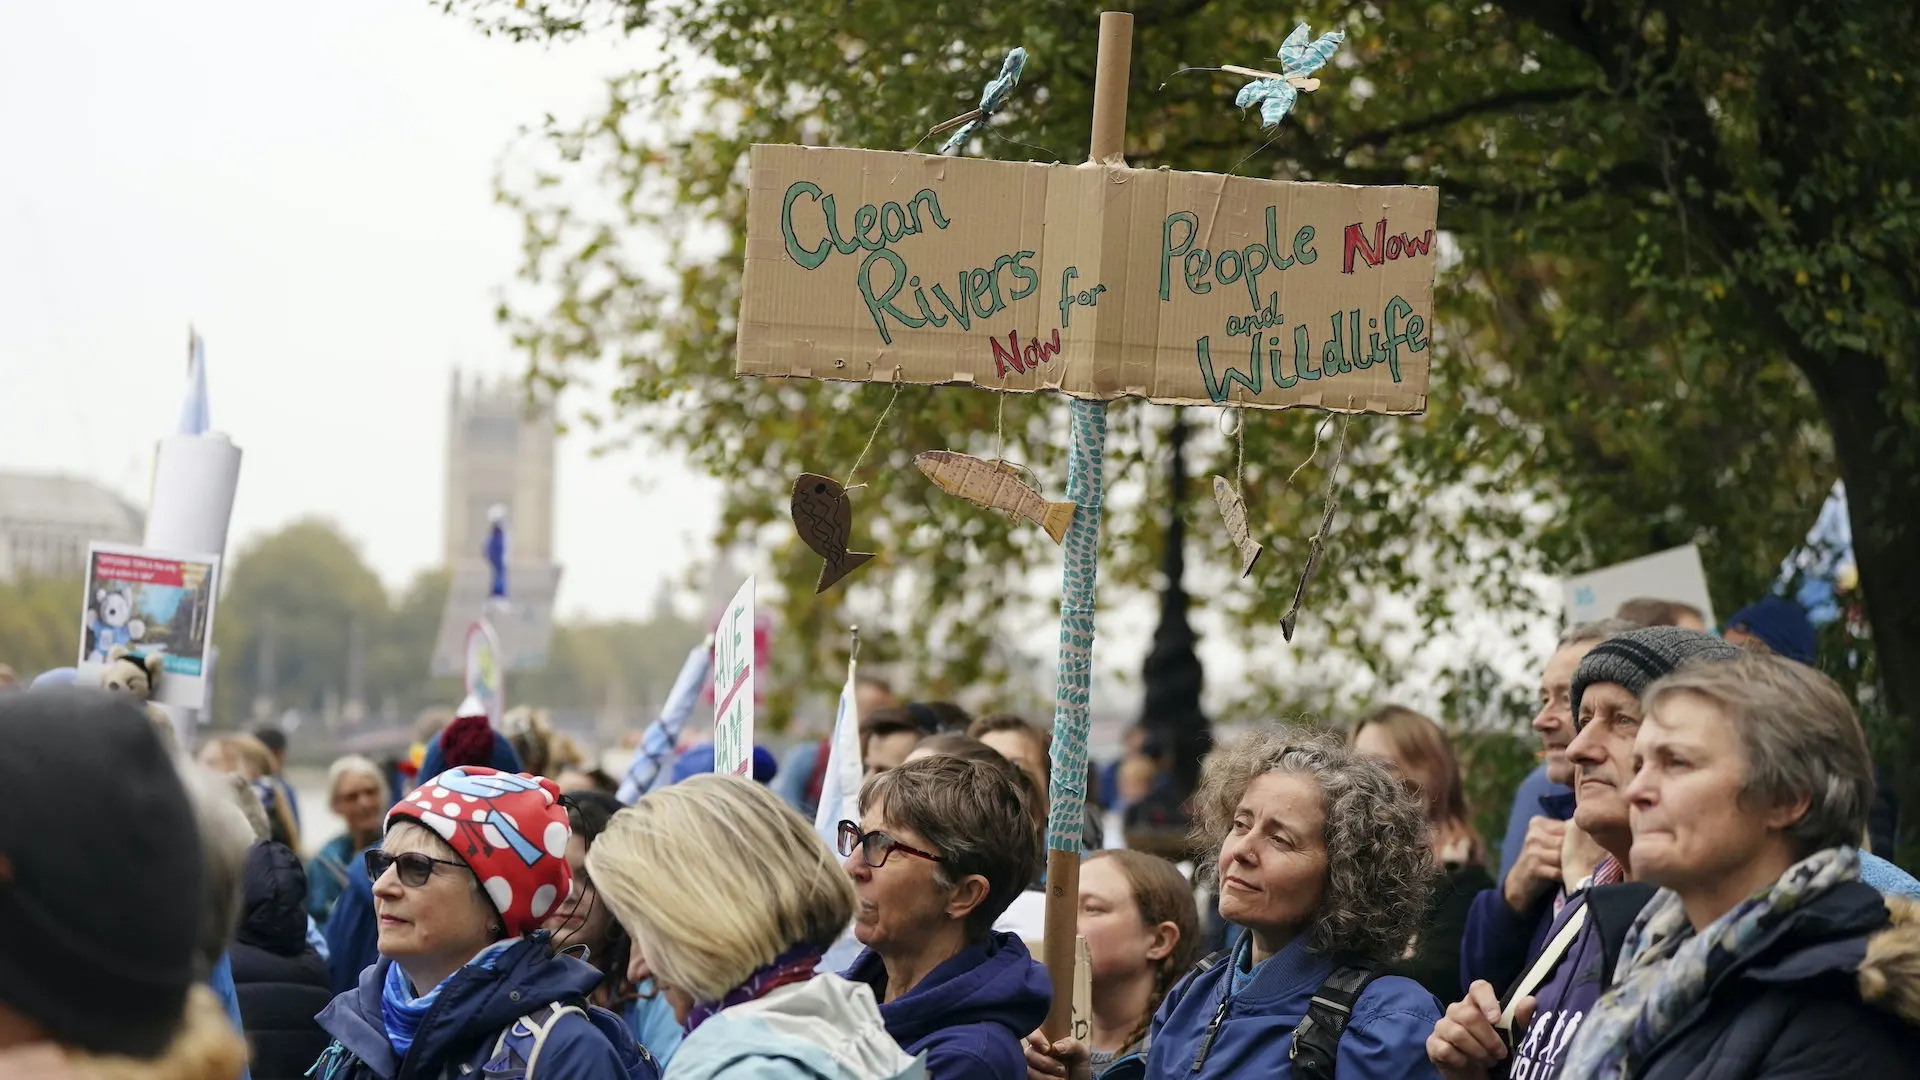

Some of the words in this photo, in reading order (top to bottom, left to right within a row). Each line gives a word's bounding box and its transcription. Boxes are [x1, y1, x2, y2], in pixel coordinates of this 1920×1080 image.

[782, 181, 951, 270] Clean
[1159, 205, 1318, 312] People
[1341, 217, 1433, 274] Now
[858, 247, 1039, 345] Rivers
[1059, 266, 1107, 329] for
[1226, 291, 1284, 337] and
[990, 328, 1061, 379] Now
[1197, 295, 1429, 403] Wildlife
